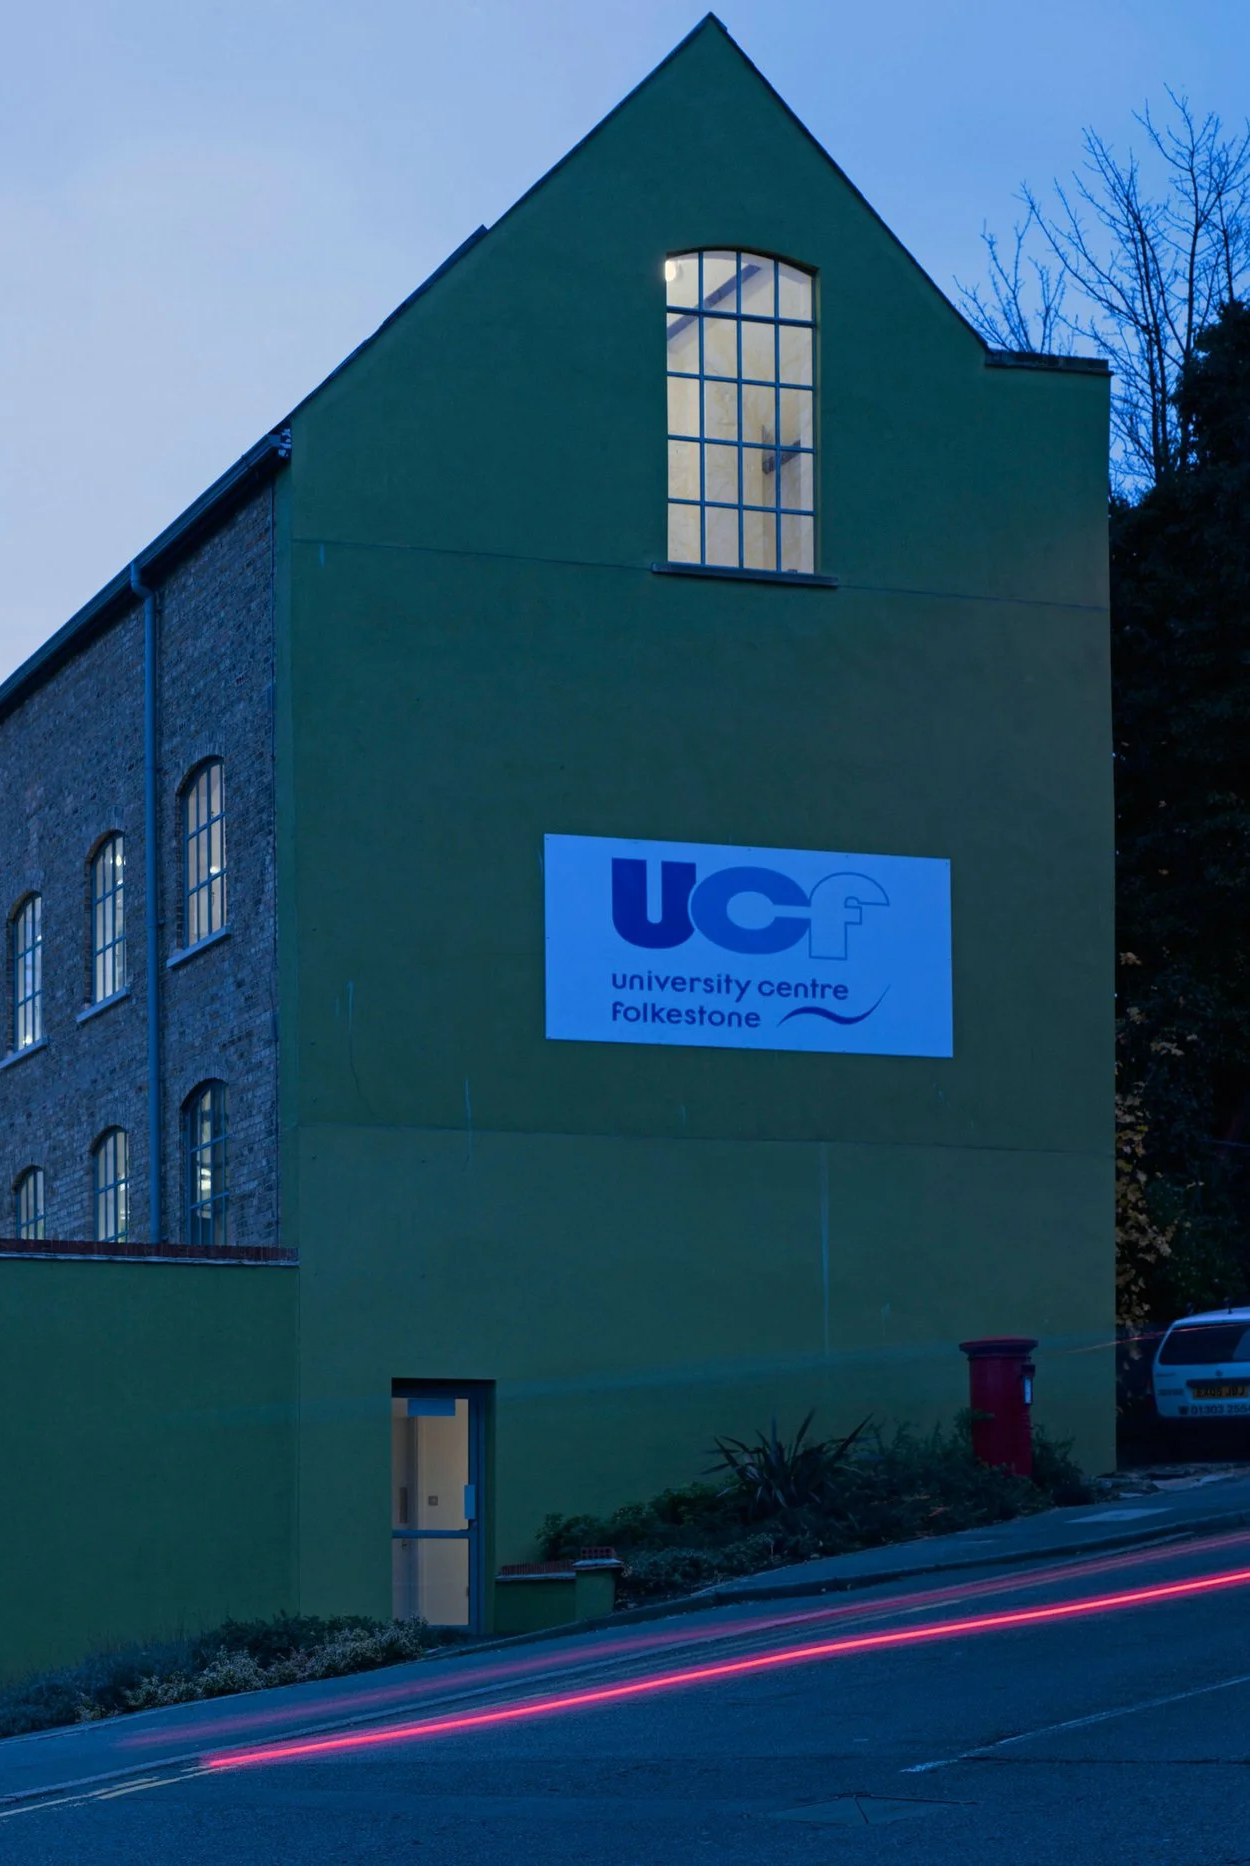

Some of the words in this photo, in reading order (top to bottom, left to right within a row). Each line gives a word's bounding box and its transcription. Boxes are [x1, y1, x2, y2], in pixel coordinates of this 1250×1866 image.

[611, 970, 753, 1004] university
[756, 978, 850, 1001] centre
[611, 1001, 762, 1029] folkestone
